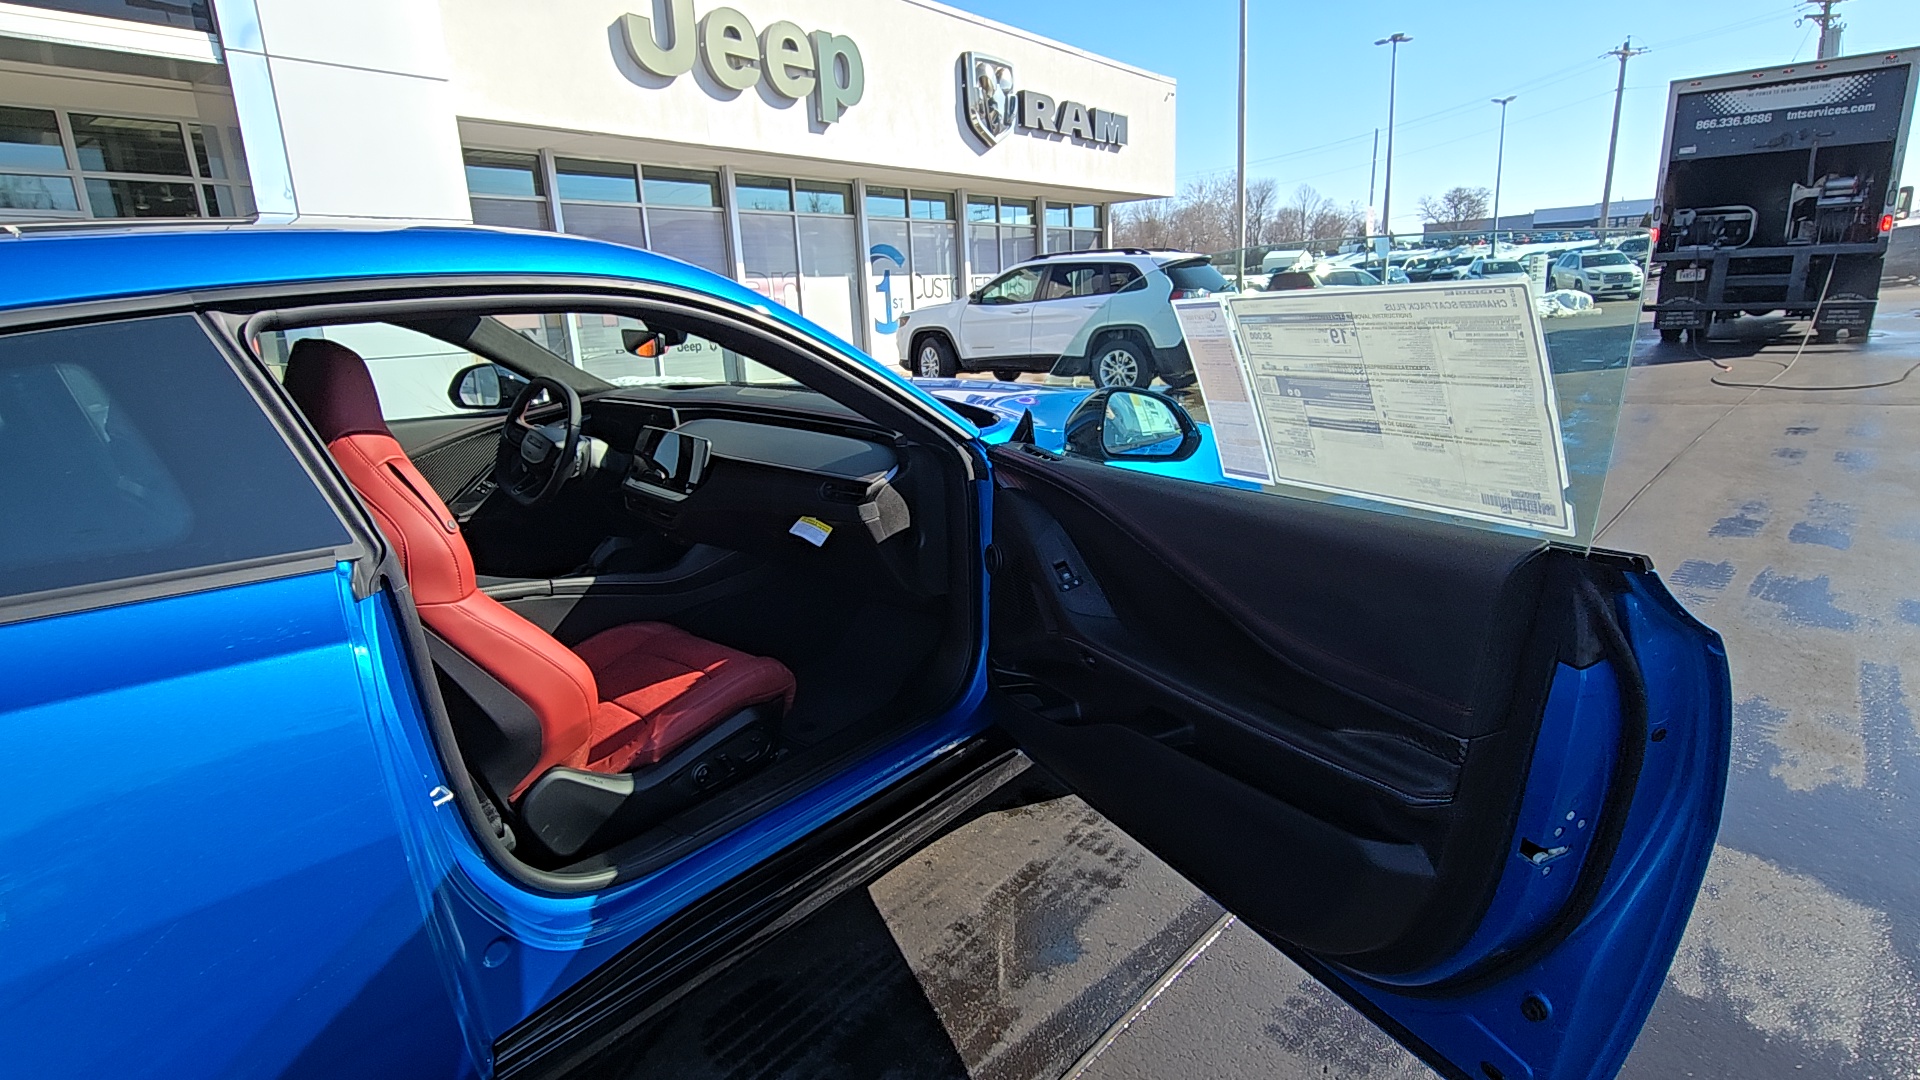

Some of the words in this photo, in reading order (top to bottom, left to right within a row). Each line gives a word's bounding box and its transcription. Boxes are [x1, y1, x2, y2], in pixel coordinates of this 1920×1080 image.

[617, 0, 865, 124] Jeep
[1019, 89, 1129, 147] RAM
[1695, 112, 1773, 130] 866.336.8686
[1786, 102, 1876, 121] tntservices.com
[676, 341, 702, 354] Jeep
